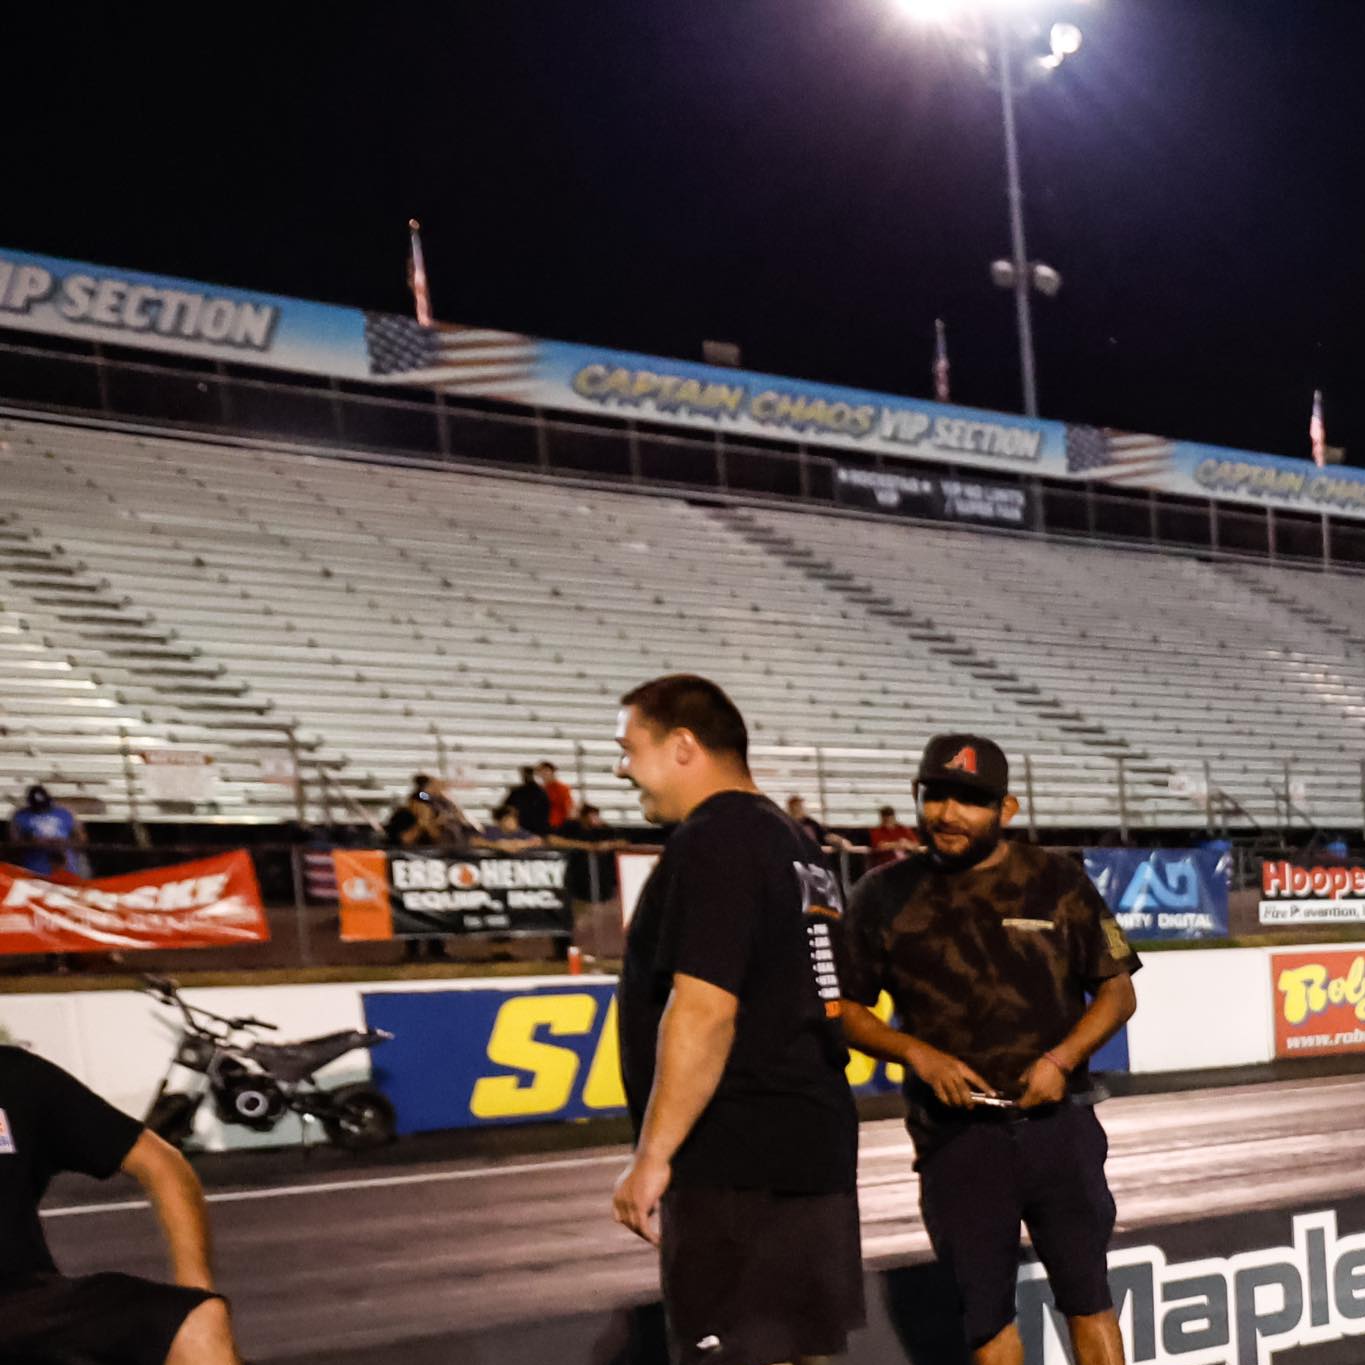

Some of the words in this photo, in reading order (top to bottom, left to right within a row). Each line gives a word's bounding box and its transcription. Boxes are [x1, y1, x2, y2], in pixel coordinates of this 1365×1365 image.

[0, 260, 52, 313] IP
[61, 274, 278, 350] SECTION
[572, 364, 744, 416] CAPTAIN
[881, 405, 931, 446] VIP
[932, 415, 1043, 461] SECTION
[479, 858, 567, 889] HENRY
